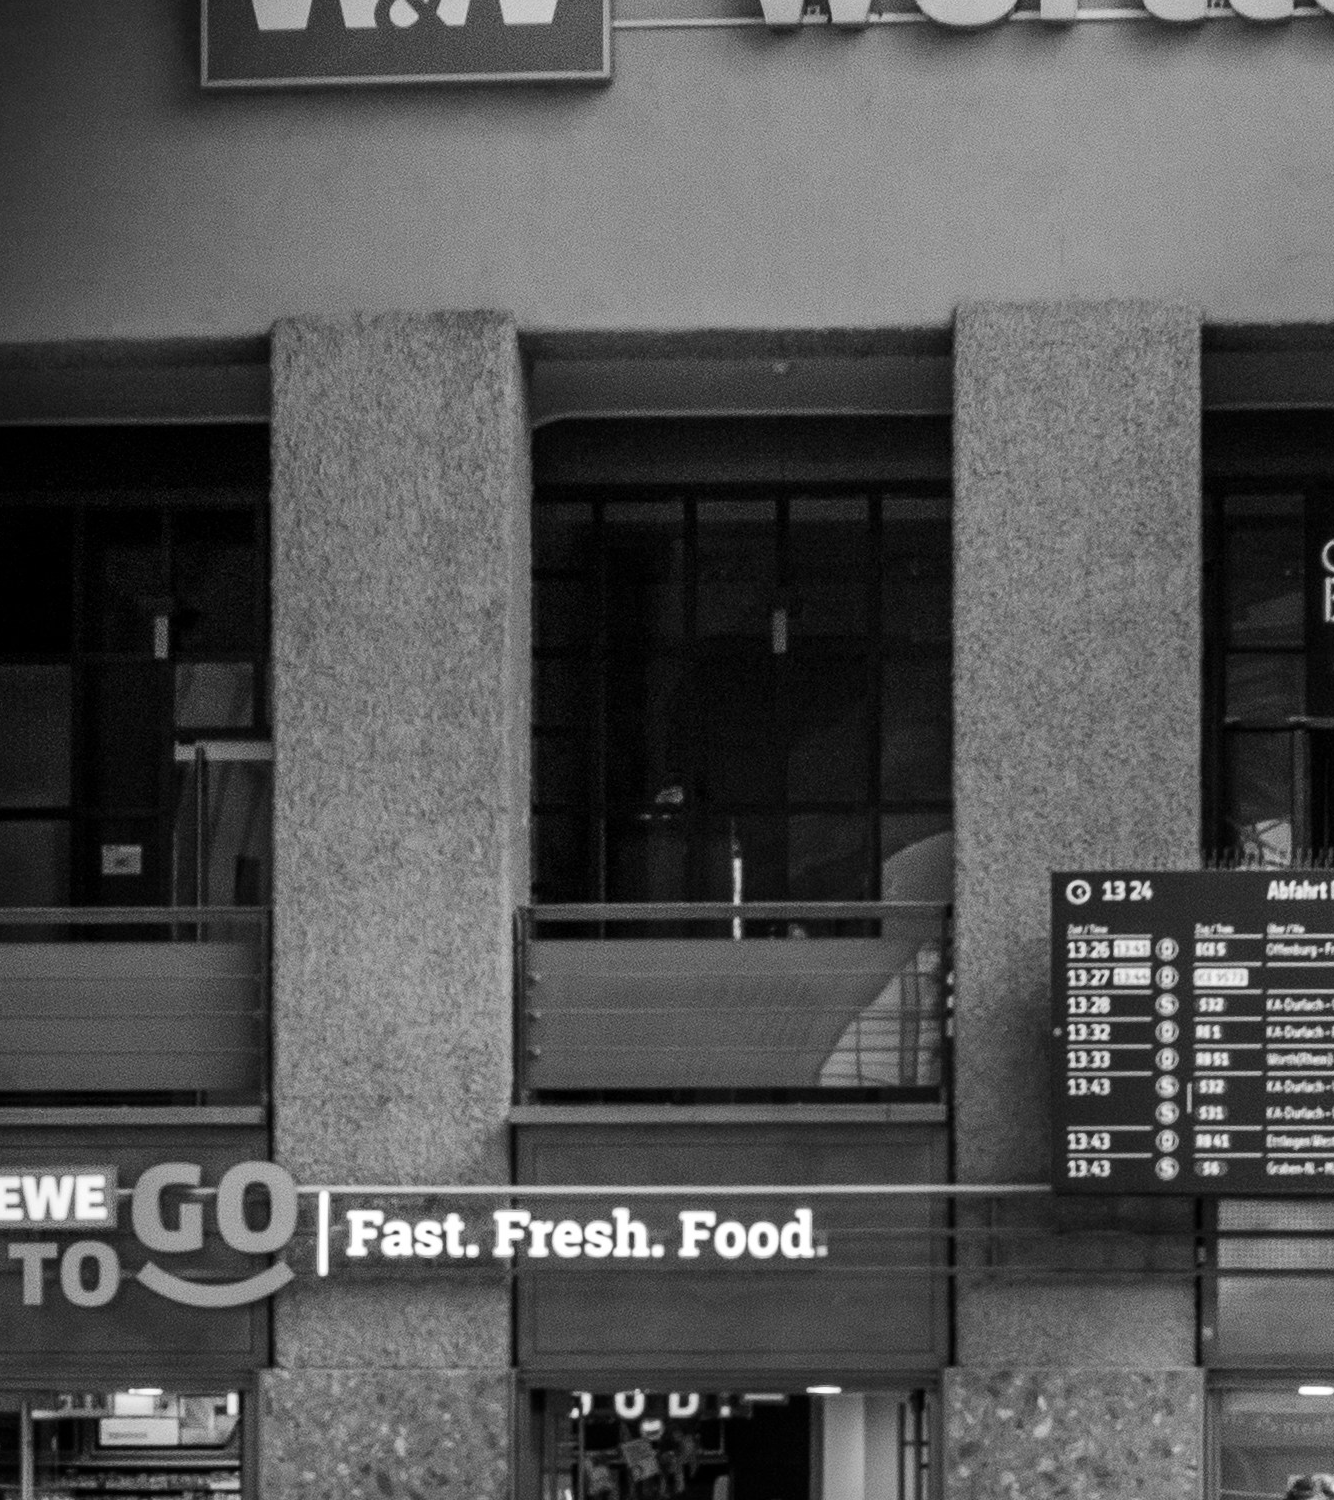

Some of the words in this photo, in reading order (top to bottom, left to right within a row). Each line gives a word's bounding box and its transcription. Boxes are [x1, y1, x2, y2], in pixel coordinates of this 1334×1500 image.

[1267, 880, 1328, 900] Abfahrt
[1067, 941, 1110, 958] 13:26
[1067, 969, 1110, 987] 13:27
[1067, 996, 1110, 1014] 13:28
[1067, 1024, 1110, 1041] 13:32
[1067, 1051, 1110, 1068] 13:33
[1068, 1078, 1110, 1095] 13:43
[1068, 1133, 1110, 1150] 13:43
[1067, 1160, 1111, 1177] 13:43
[131, 1160, 300, 1254] GO
[347, 1208, 481, 1259] Fast.
[493, 1208, 666, 1259] Fresh.
[677, 1208, 829, 1259] Food.
[8, 1241, 122, 1308] TO
